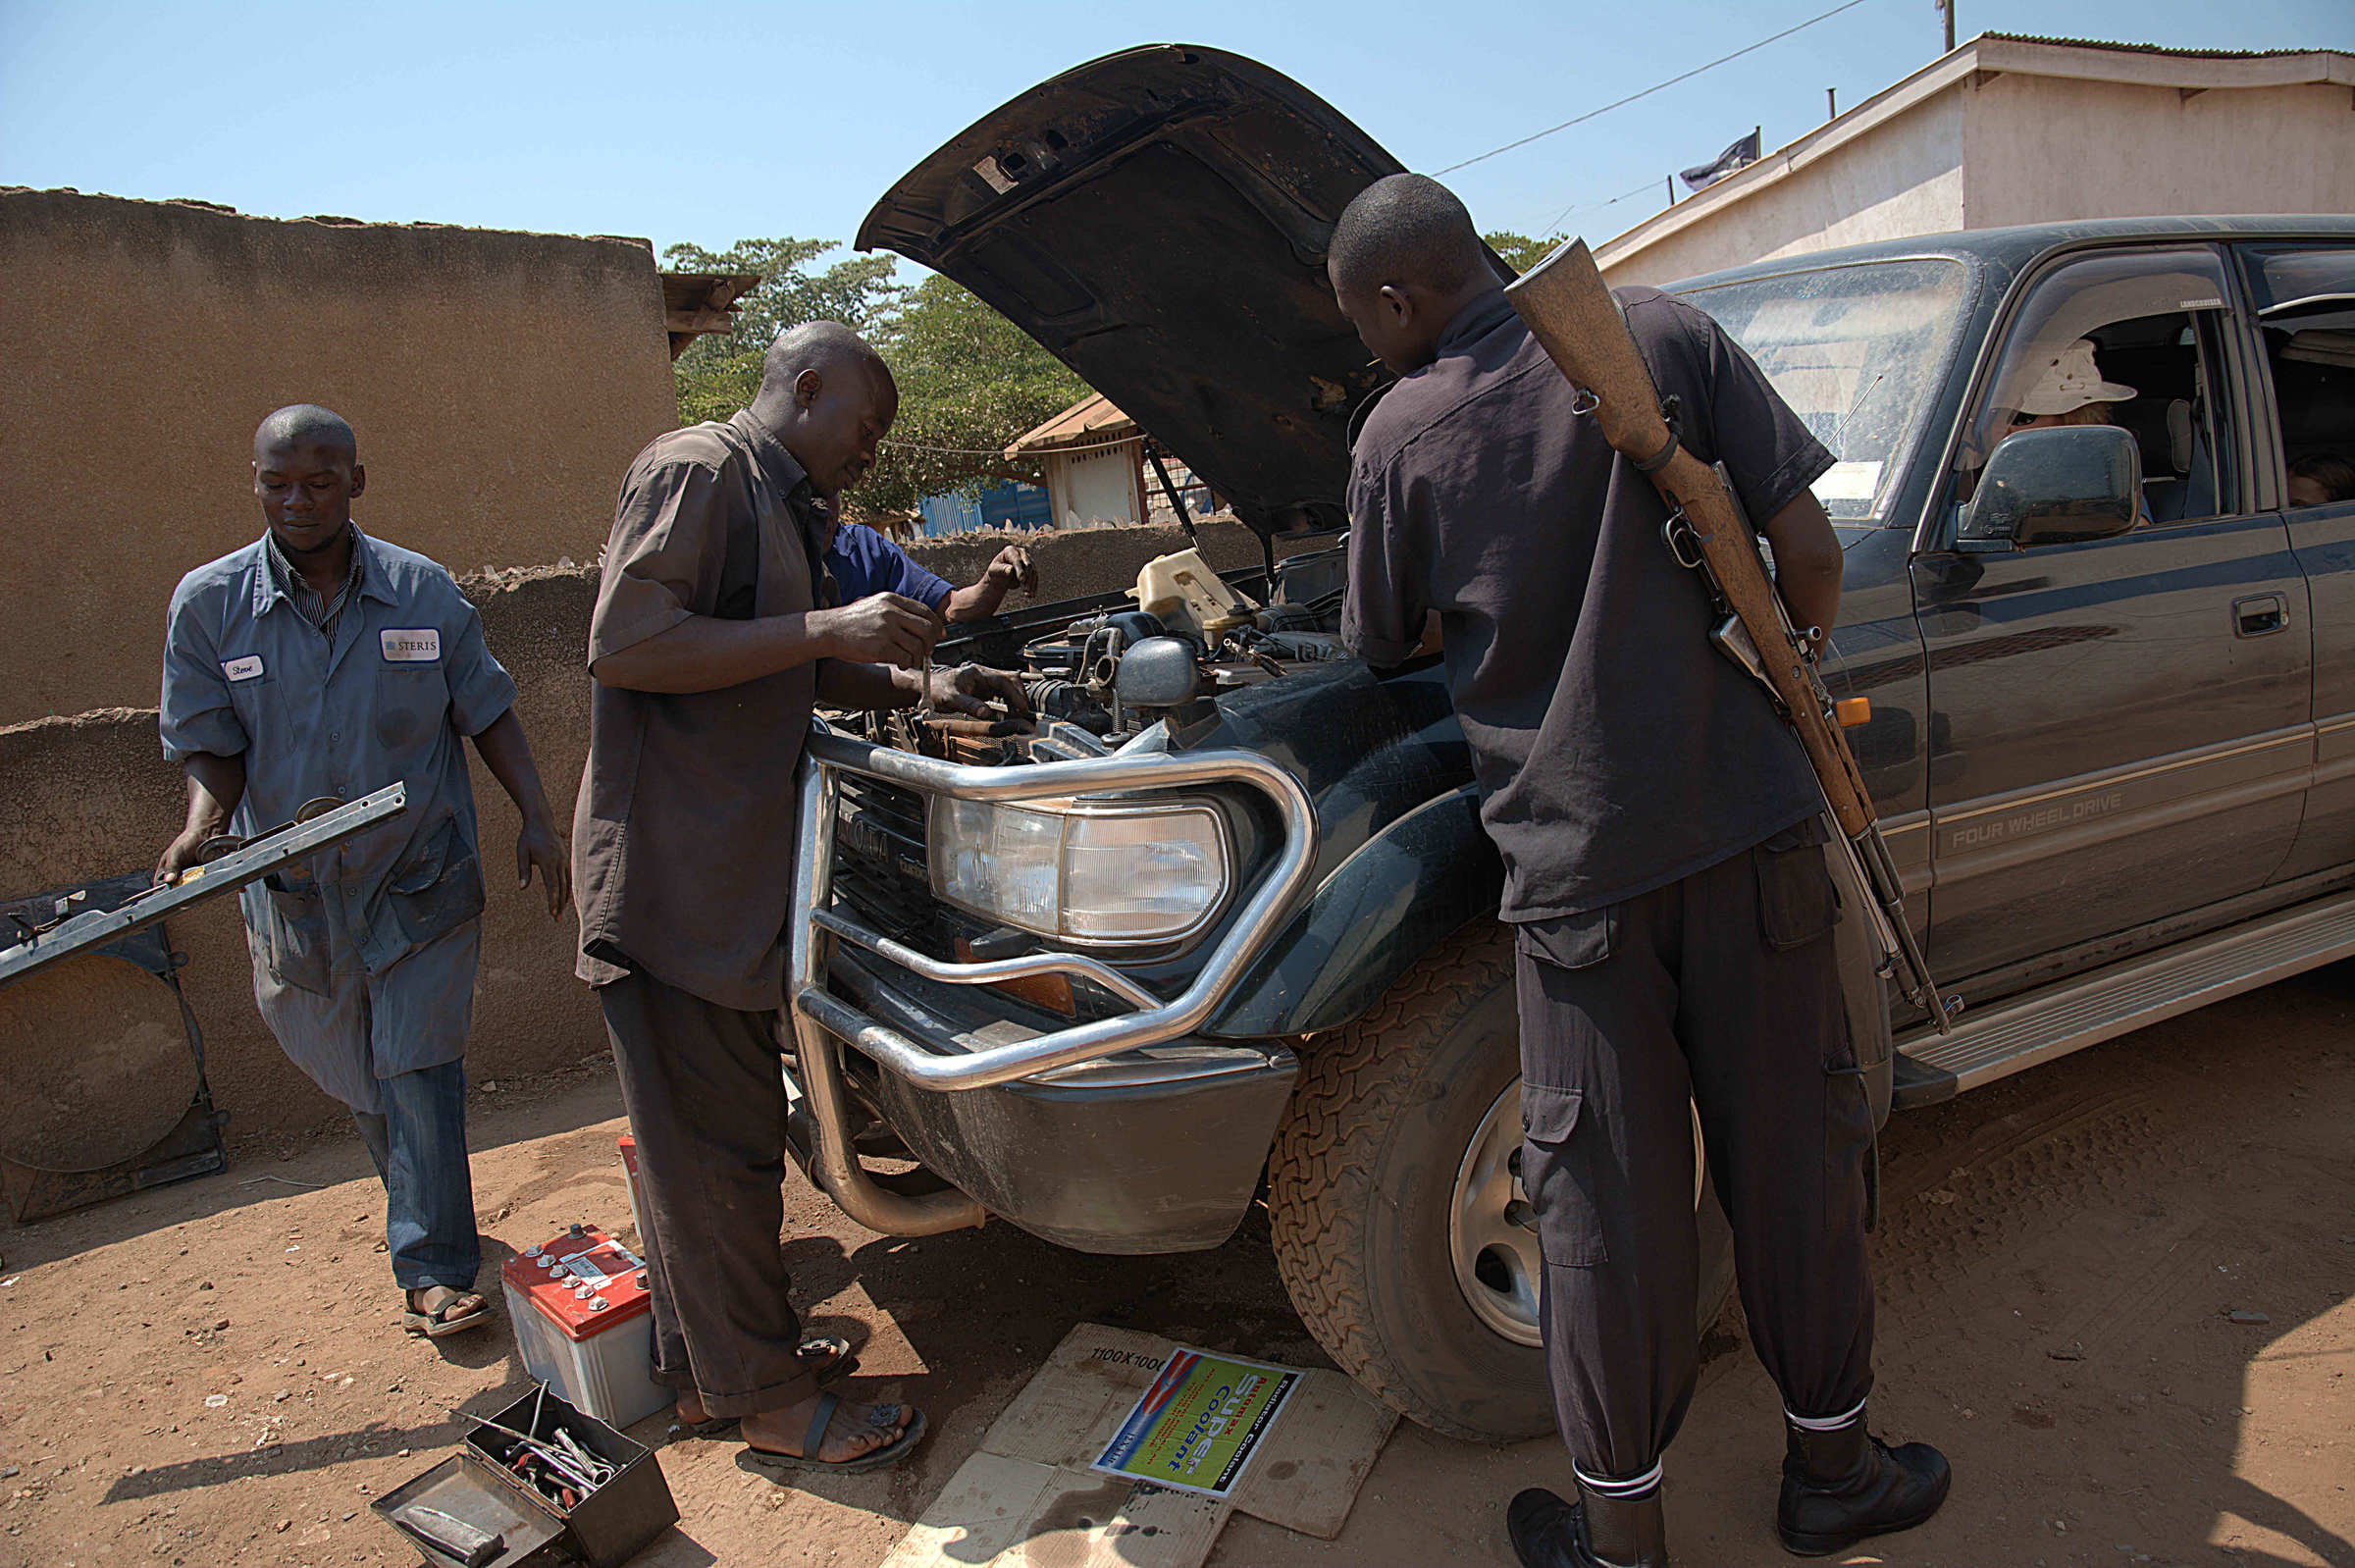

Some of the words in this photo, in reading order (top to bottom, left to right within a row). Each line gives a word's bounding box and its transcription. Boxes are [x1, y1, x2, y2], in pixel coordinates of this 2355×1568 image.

[398, 642, 437, 652] STERIS
[1952, 821, 2004, 849] FOUR
[2009, 808, 2070, 834] WHEEL
[2072, 793, 2122, 818] DRIVE
[1167, 1385, 1230, 1472] Coolant
[1185, 1373, 1259, 1474] Super
[1224, 1376, 1268, 1436] Automax
[1254, 1380, 1289, 1431] Radiator
[1219, 1434, 1254, 1483] Coolant
